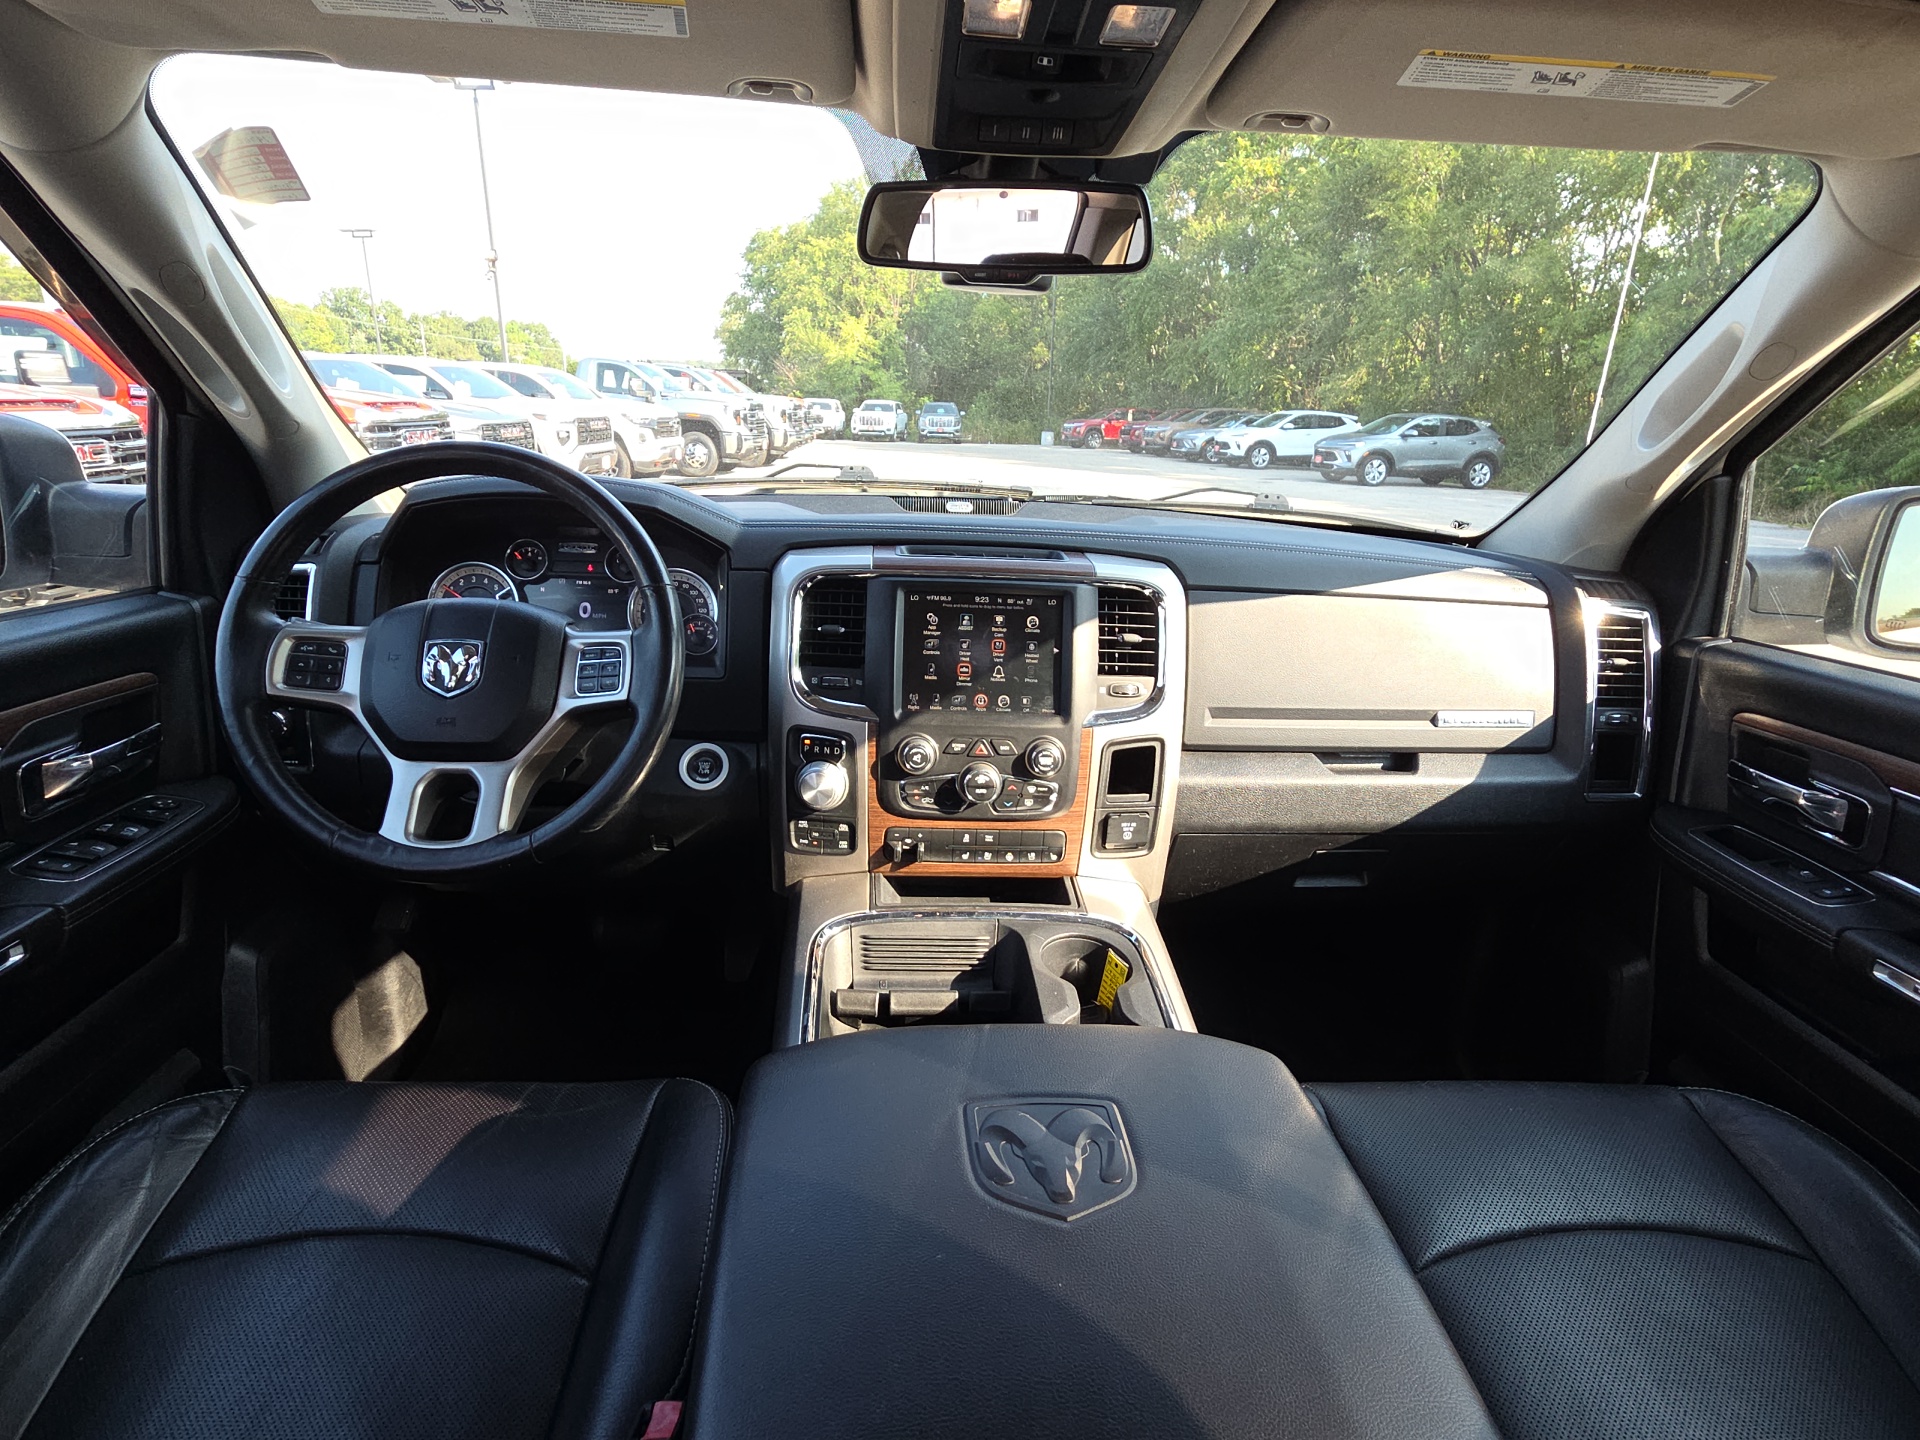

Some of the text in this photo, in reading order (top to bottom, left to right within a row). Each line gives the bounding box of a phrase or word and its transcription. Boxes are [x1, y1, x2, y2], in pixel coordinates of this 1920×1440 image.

[1442, 51, 1491, 60] WARNING
[1675, 68, 1711, 76] GARDE
[459, 578, 464, 586] 2
[483, 577, 489, 585] 4
[579, 601, 591, 618] 0
[823, 746, 830, 754] N
[834, 747, 840, 755] D
